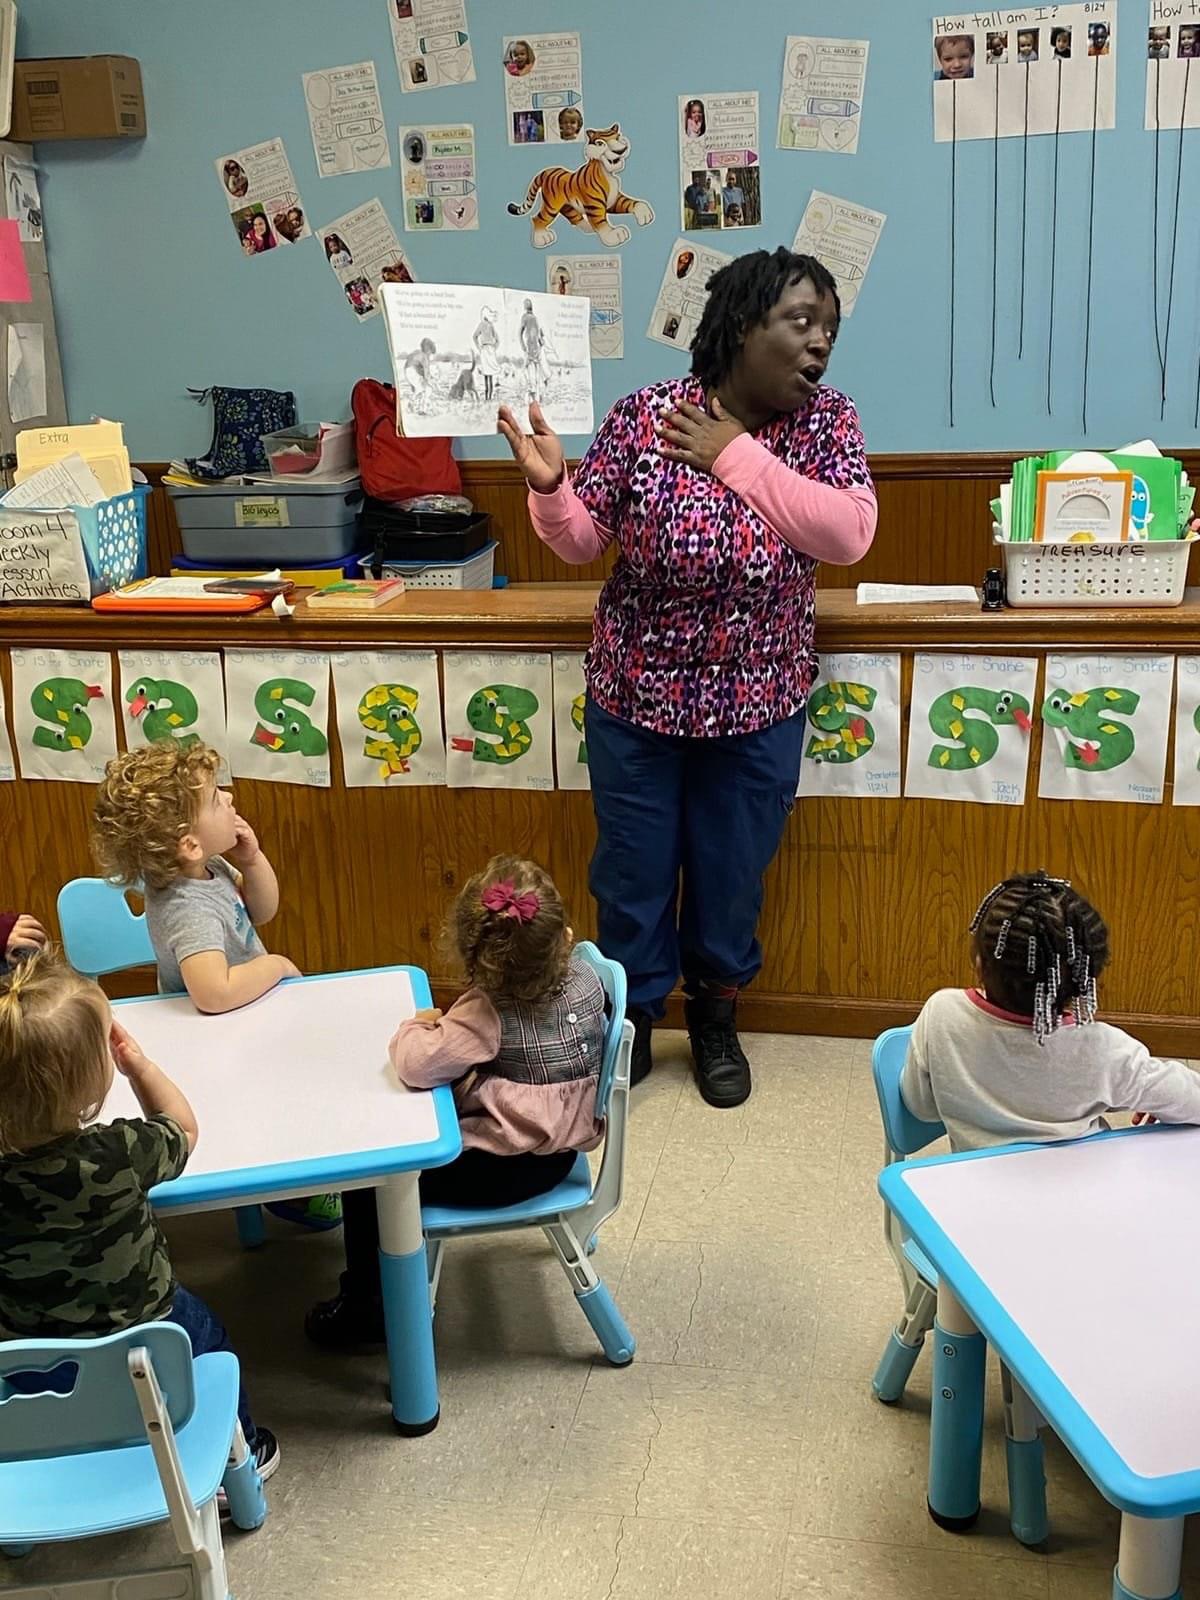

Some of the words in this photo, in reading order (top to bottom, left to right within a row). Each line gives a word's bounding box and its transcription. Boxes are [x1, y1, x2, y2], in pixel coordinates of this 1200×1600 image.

[1153, 0, 1182, 20] How
[936, 17, 965, 35] How
[972, 11, 1002, 28] tall
[1006, 13, 1027, 25] am
[40, 432, 69, 444] Extra
[0, 524, 43, 540] oom
[46, 514, 68, 540] 4
[0, 544, 50, 568] eekly
[0, 567, 52, 581] esson
[2, 581, 82, 598] Activities
[826, 655, 842, 671] for
[849, 654, 893, 671] Snake
[918, 653, 934, 674] S
[941, 660, 955, 671] is
[960, 655, 976, 671] for
[982, 656, 1025, 673] Snake
[1050, 653, 1068, 680] S
[1075, 662, 1090, 676] is
[1096, 654, 1113, 674] for
[1122, 656, 1170, 674] Snake
[992, 781, 1021, 796] Jack
